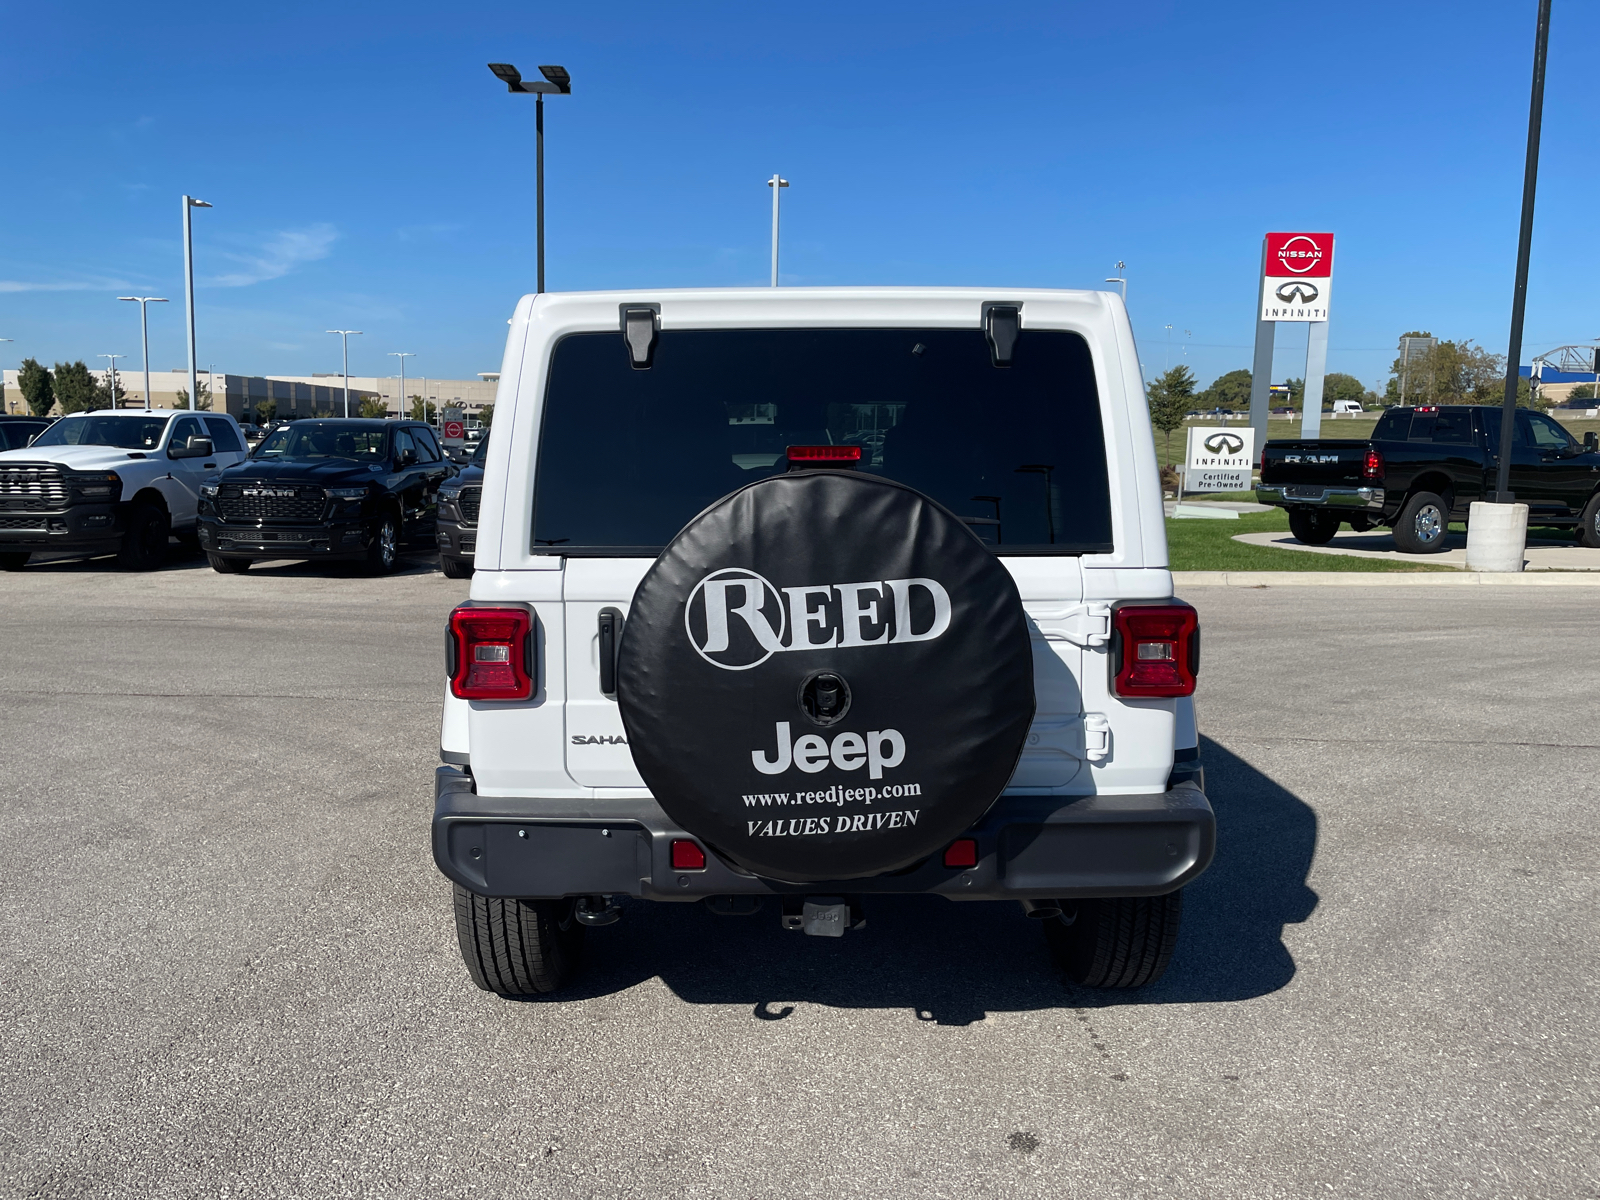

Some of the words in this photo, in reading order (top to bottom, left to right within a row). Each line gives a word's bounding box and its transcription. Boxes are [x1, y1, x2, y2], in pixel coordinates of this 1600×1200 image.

[1265, 308, 1326, 317] INFINITI
[1196, 458, 1249, 466] INFINITI
[1285, 455, 1338, 464] RAM
[242, 488, 295, 497] RAM
[701, 577, 951, 652] REED
[752, 721, 906, 779] Jeep
[742, 782, 922, 807] www.reedjeep.com
[747, 817, 831, 837] VALUES
[834, 809, 920, 833] DRIVEN
